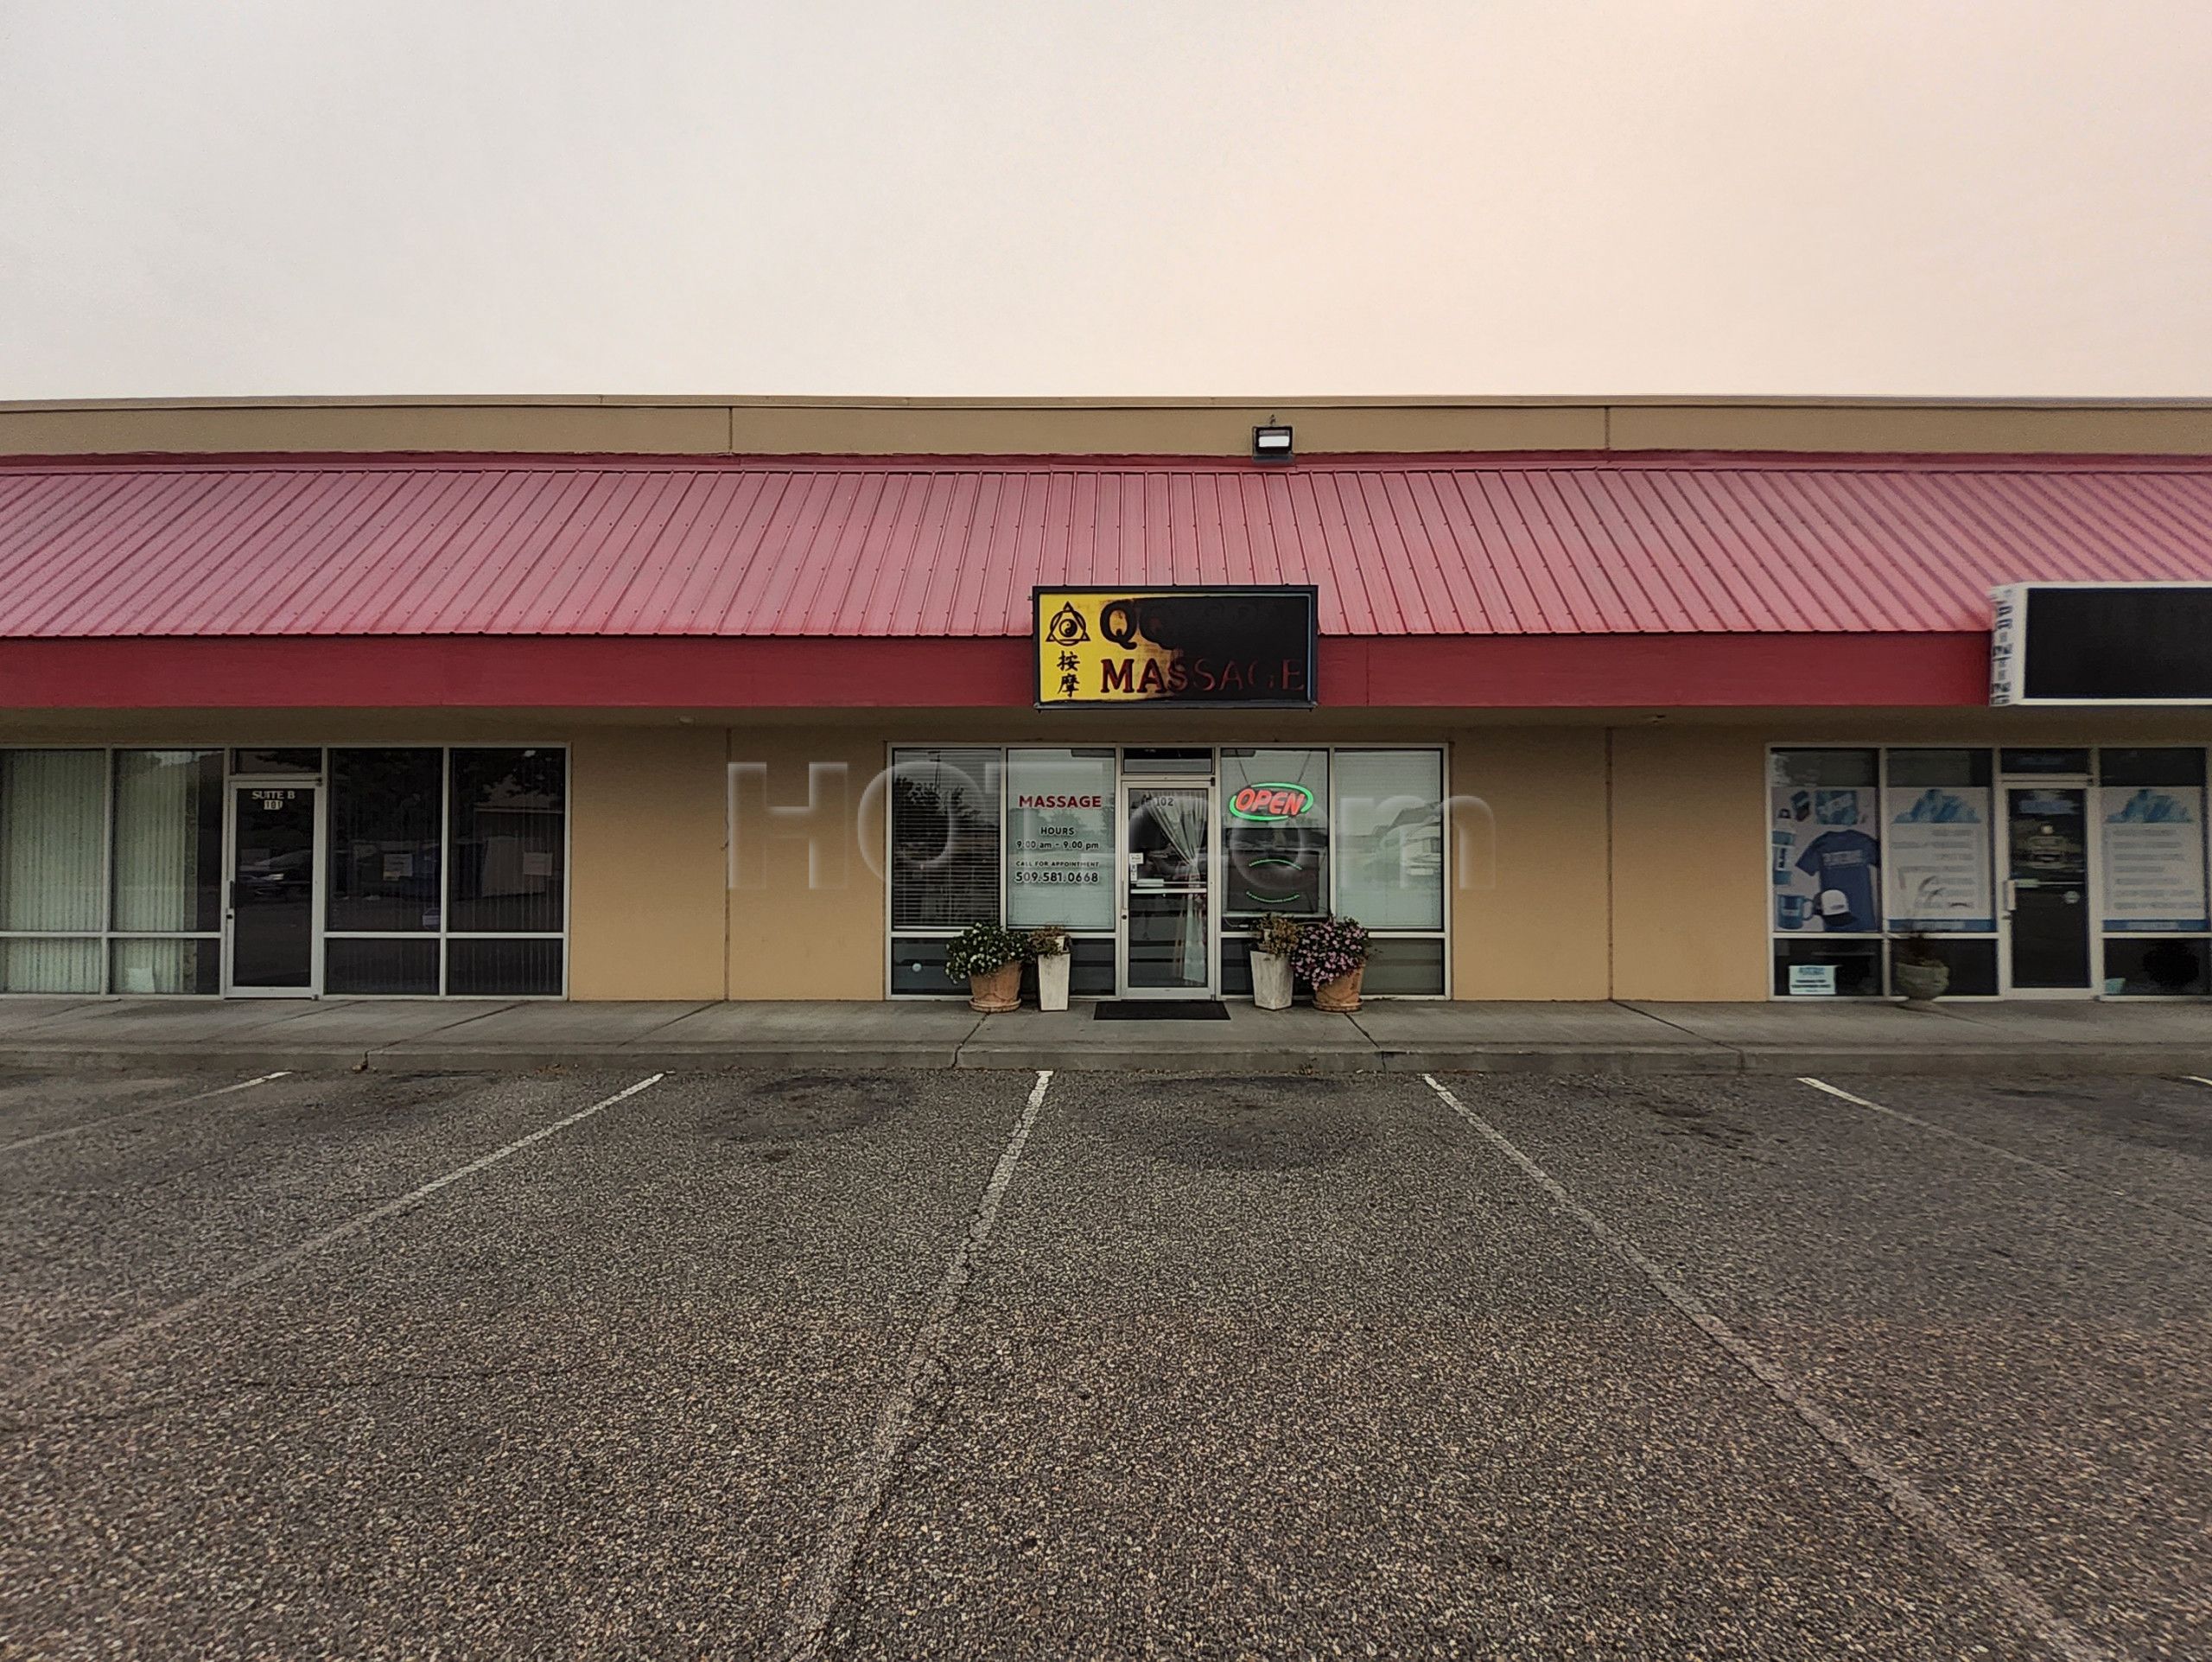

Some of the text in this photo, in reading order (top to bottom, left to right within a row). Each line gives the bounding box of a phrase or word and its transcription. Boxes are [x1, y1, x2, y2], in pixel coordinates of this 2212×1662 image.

[251, 790, 296, 799] SUITE B
[1019, 795, 1102, 808] MASSAGE
[1157, 797, 1174, 806] 102
[1236, 788, 1306, 815] OPEN
[1040, 827, 1075, 836] HOURS
[1085, 842, 1099, 850] pm
[1015, 871, 1098, 882] 509.581.0668
